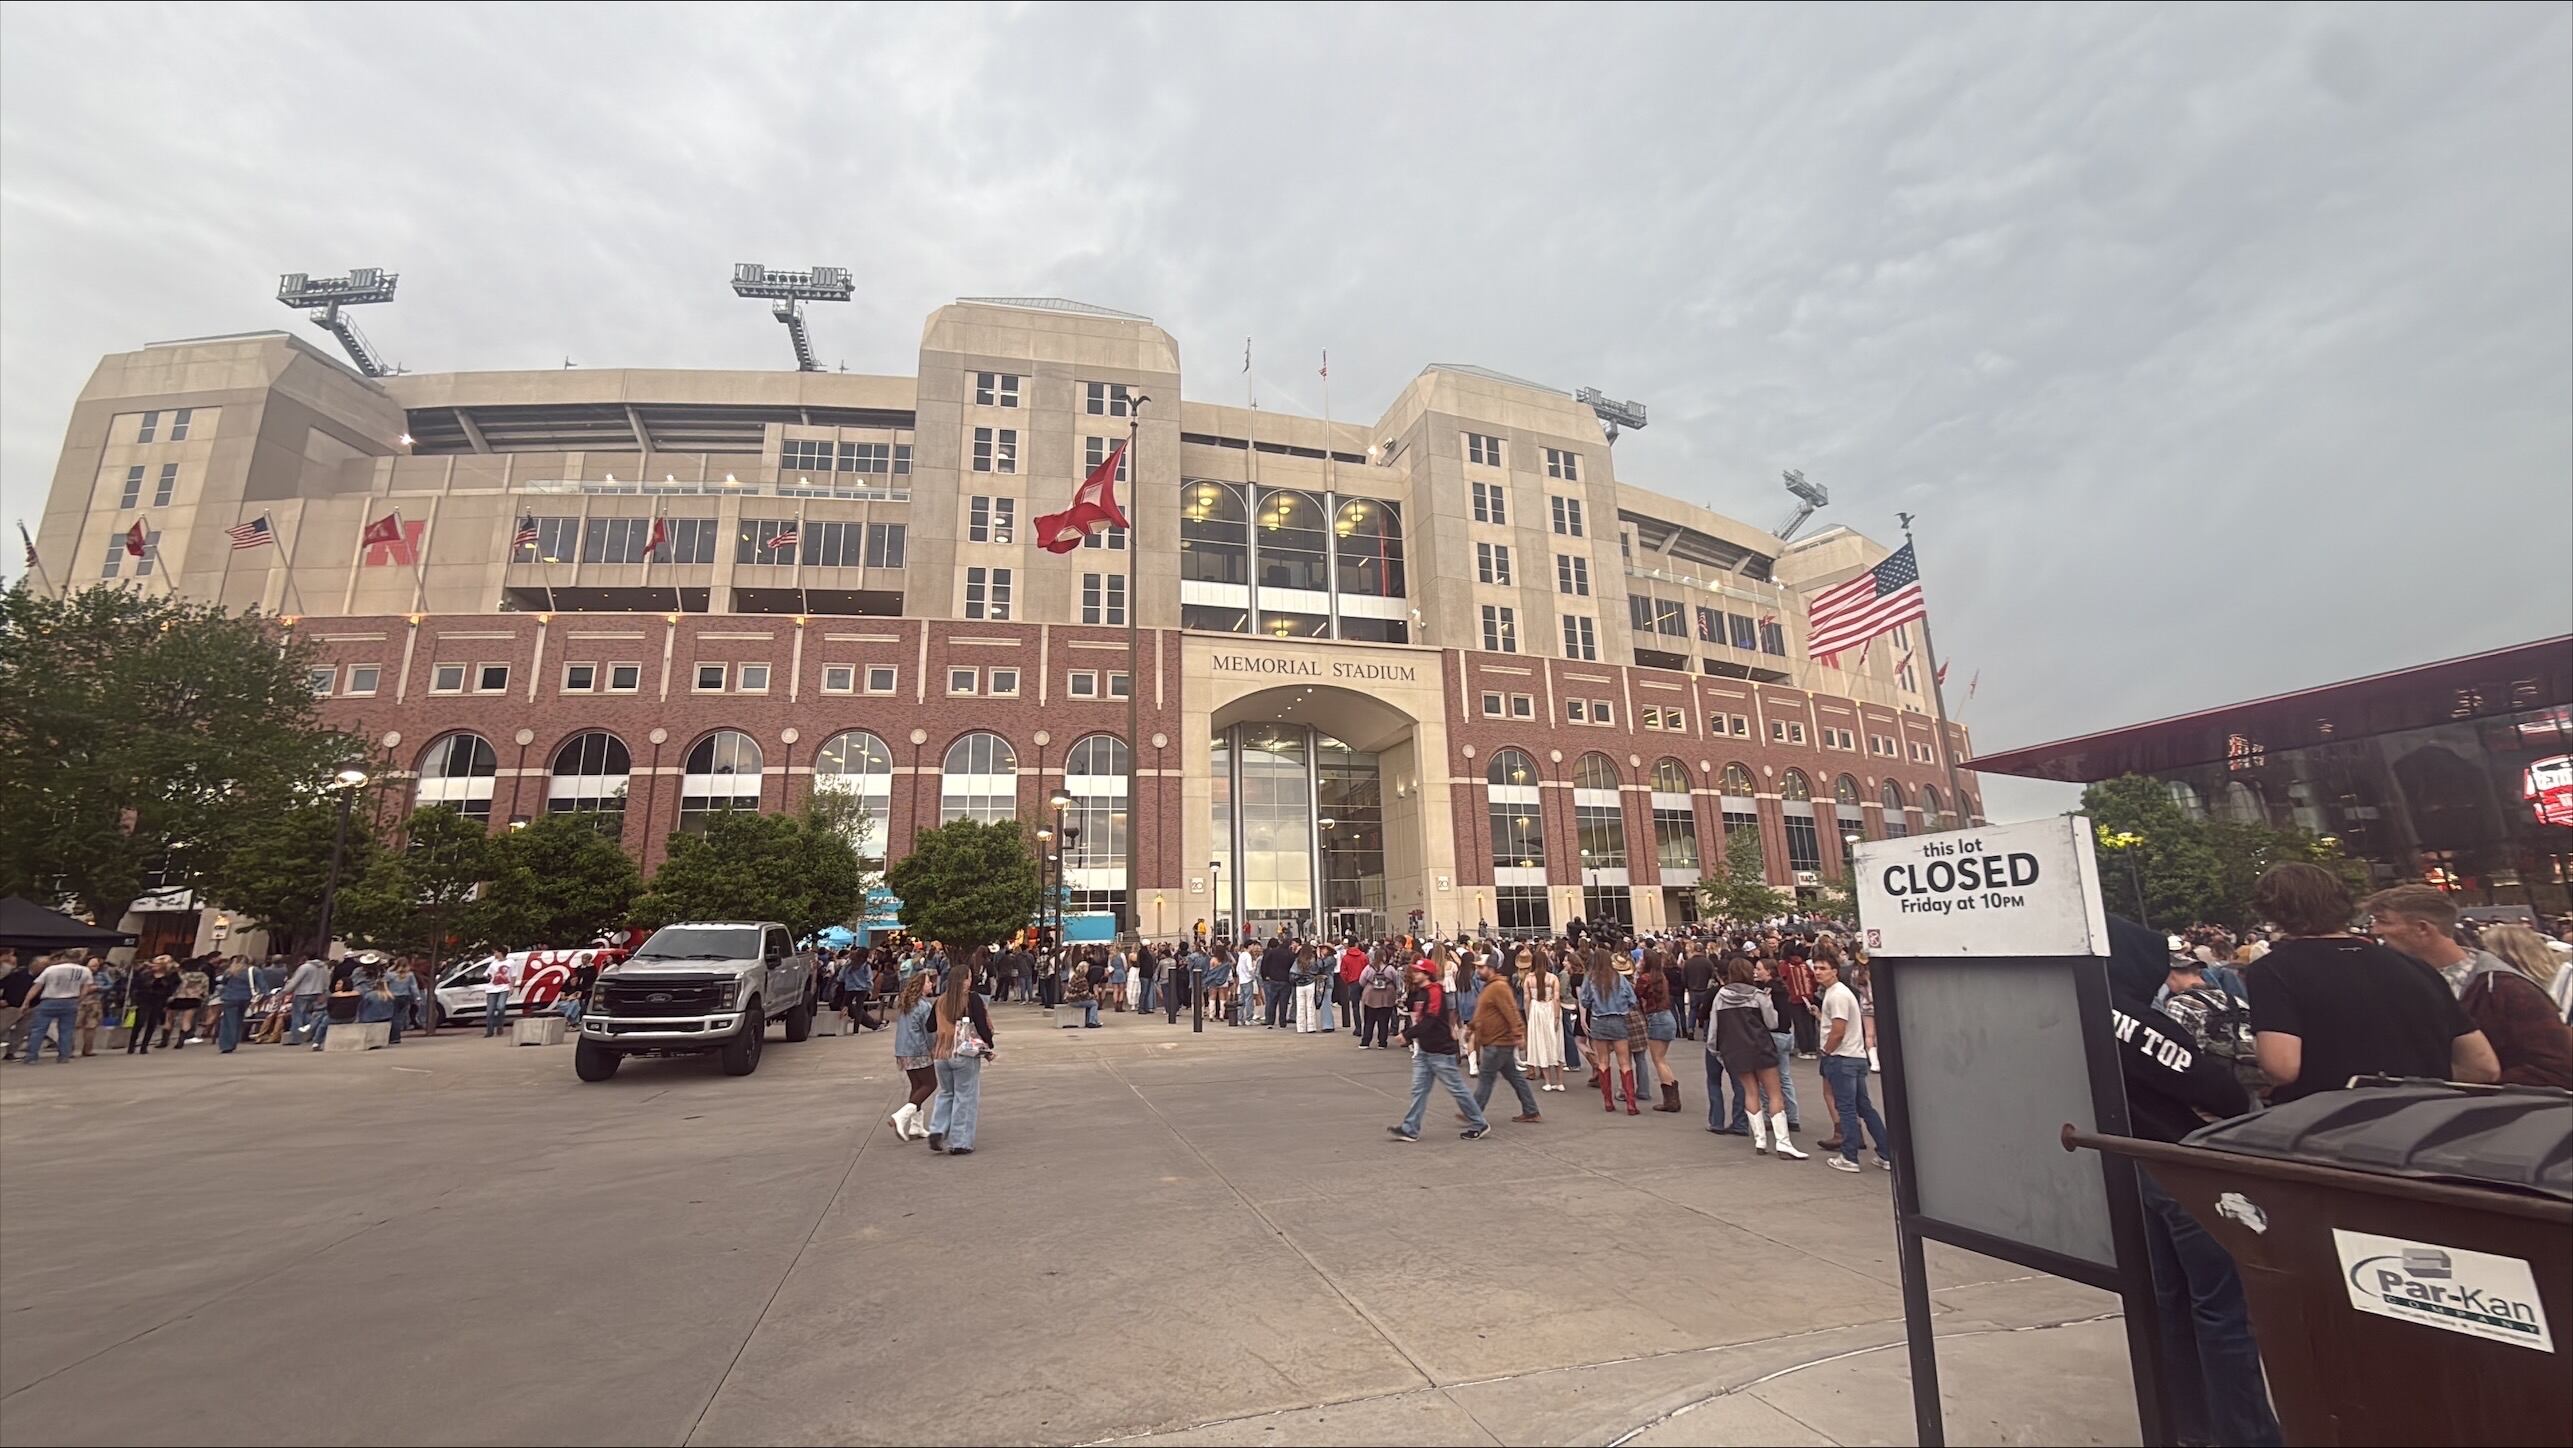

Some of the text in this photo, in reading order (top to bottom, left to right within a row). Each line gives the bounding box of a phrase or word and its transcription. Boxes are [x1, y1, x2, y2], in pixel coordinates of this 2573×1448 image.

[1213, 655, 1415, 681] MEMORIAL STADIUM
[1923, 838, 1983, 858] this lot
[1191, 881, 1204, 890] 20
[1883, 852, 2040, 897] CLOSED
[1901, 896, 1952, 915] Friday
[1957, 896, 1975, 911] at
[2140, 1026, 2193, 1073] TOP
[2376, 1269, 2536, 1323] Par-Kan
[2386, 1296, 2540, 1334] COMPANY
